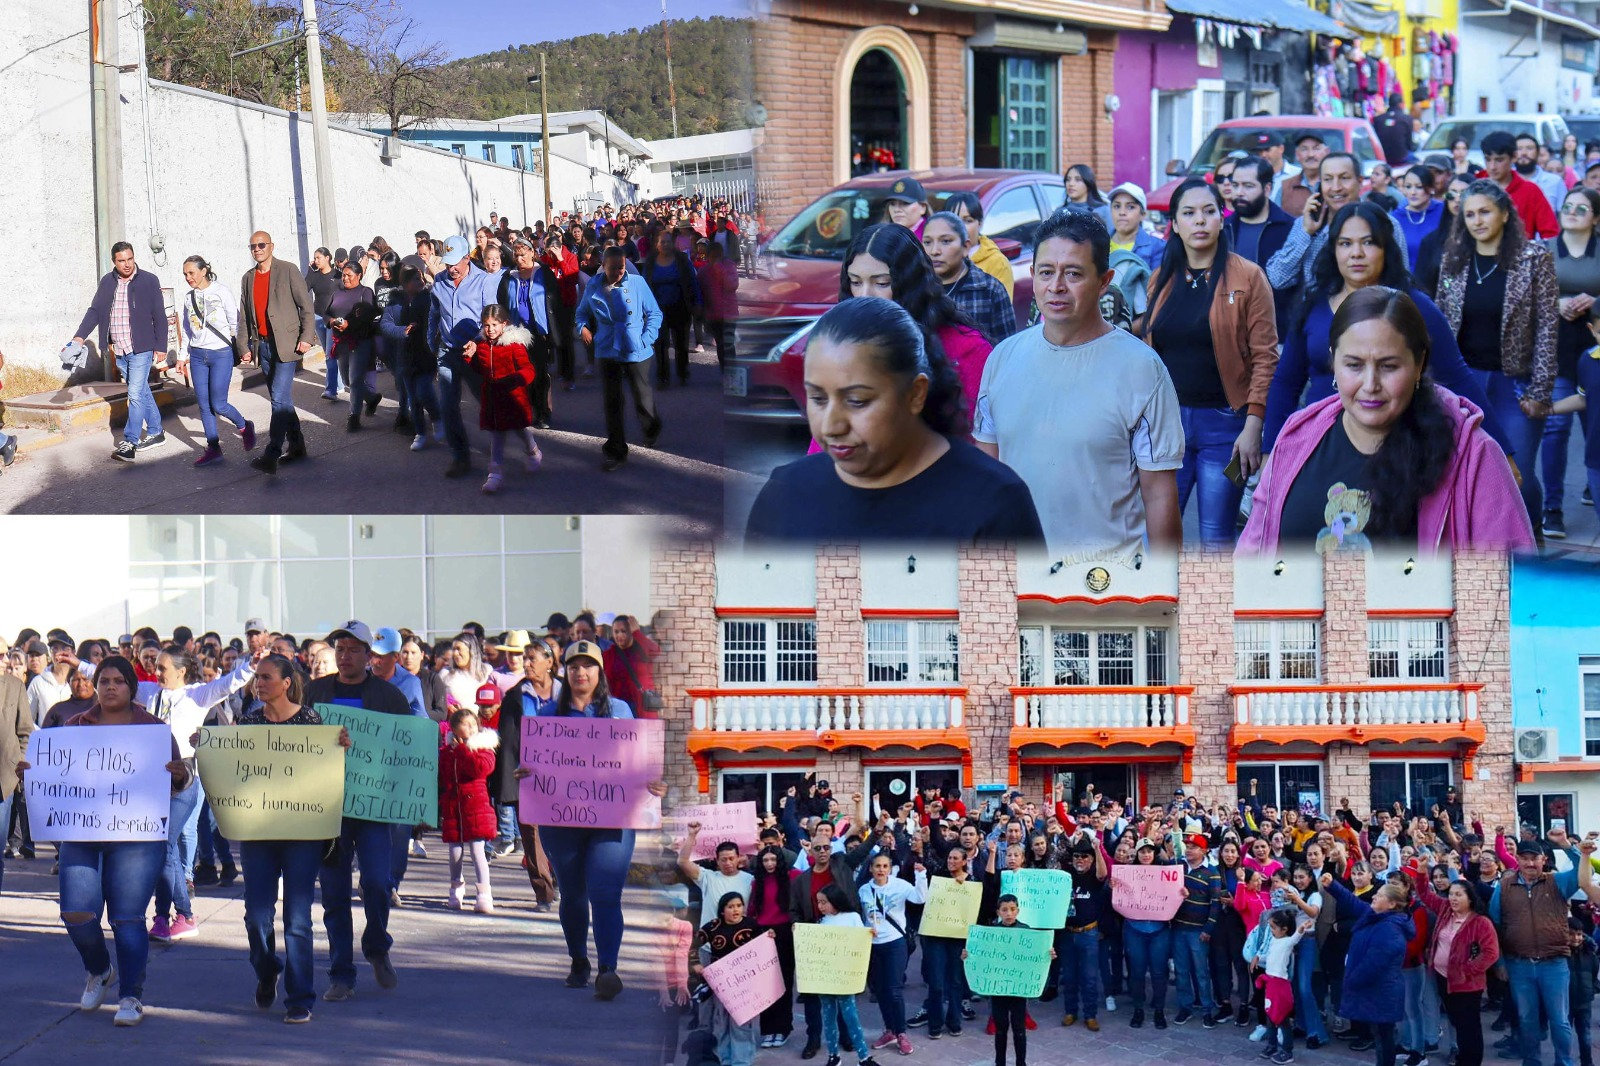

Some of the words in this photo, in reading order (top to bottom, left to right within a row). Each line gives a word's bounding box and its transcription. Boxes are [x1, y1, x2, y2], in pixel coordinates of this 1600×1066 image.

[1061, 549, 1135, 570] MUNICIPAL
[198, 728, 255, 750] Derechos
[267, 729, 324, 755] laborales
[391, 721, 412, 746] los
[554, 722, 580, 738] Diaz
[587, 724, 600, 740] de
[36, 737, 76, 777] Hoy
[86, 747, 135, 775] ellos,
[380, 748, 435, 772] laborales
[551, 749, 586, 768] Gloria
[236, 760, 273, 782] Igual
[284, 765, 293, 778] a
[31, 780, 96, 799] mañana
[408, 779, 426, 798] la
[533, 774, 557, 796] NO
[567, 780, 626, 803] estan
[262, 792, 324, 813] humanos
[107, 815, 168, 834] despidos!
[1161, 870, 1179, 882] NO
